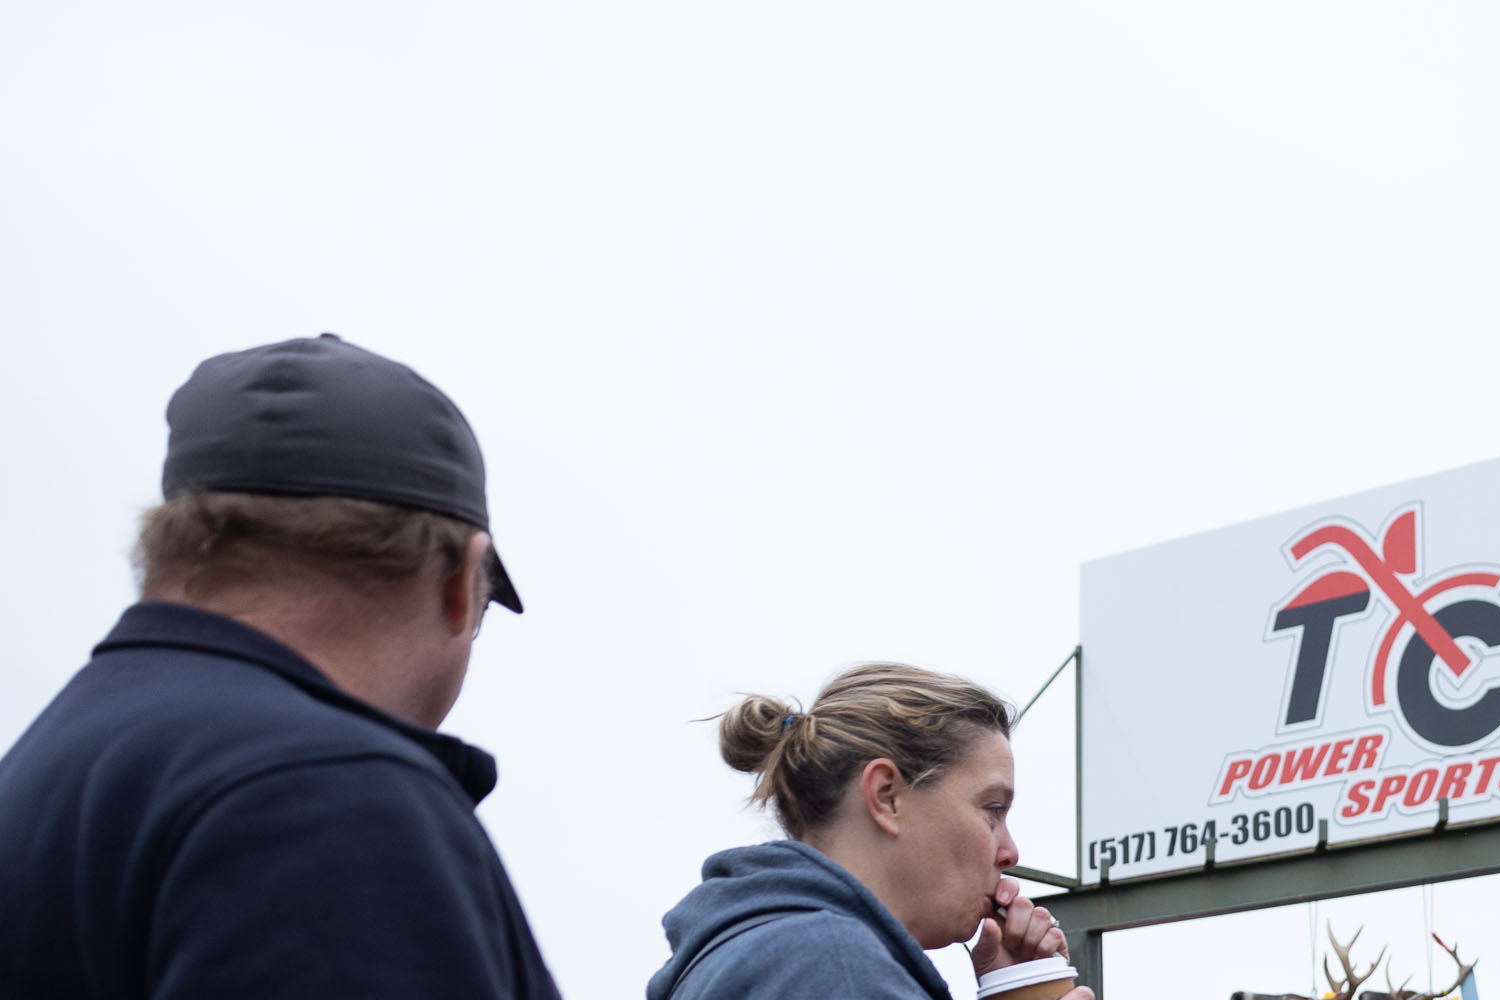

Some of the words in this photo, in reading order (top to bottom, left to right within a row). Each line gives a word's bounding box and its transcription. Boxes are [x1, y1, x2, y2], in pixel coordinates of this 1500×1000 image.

[1217, 733, 1384, 797] POWER
[1088, 831, 1156, 870] (517)
[1164, 802, 1314, 857] 764-3600
